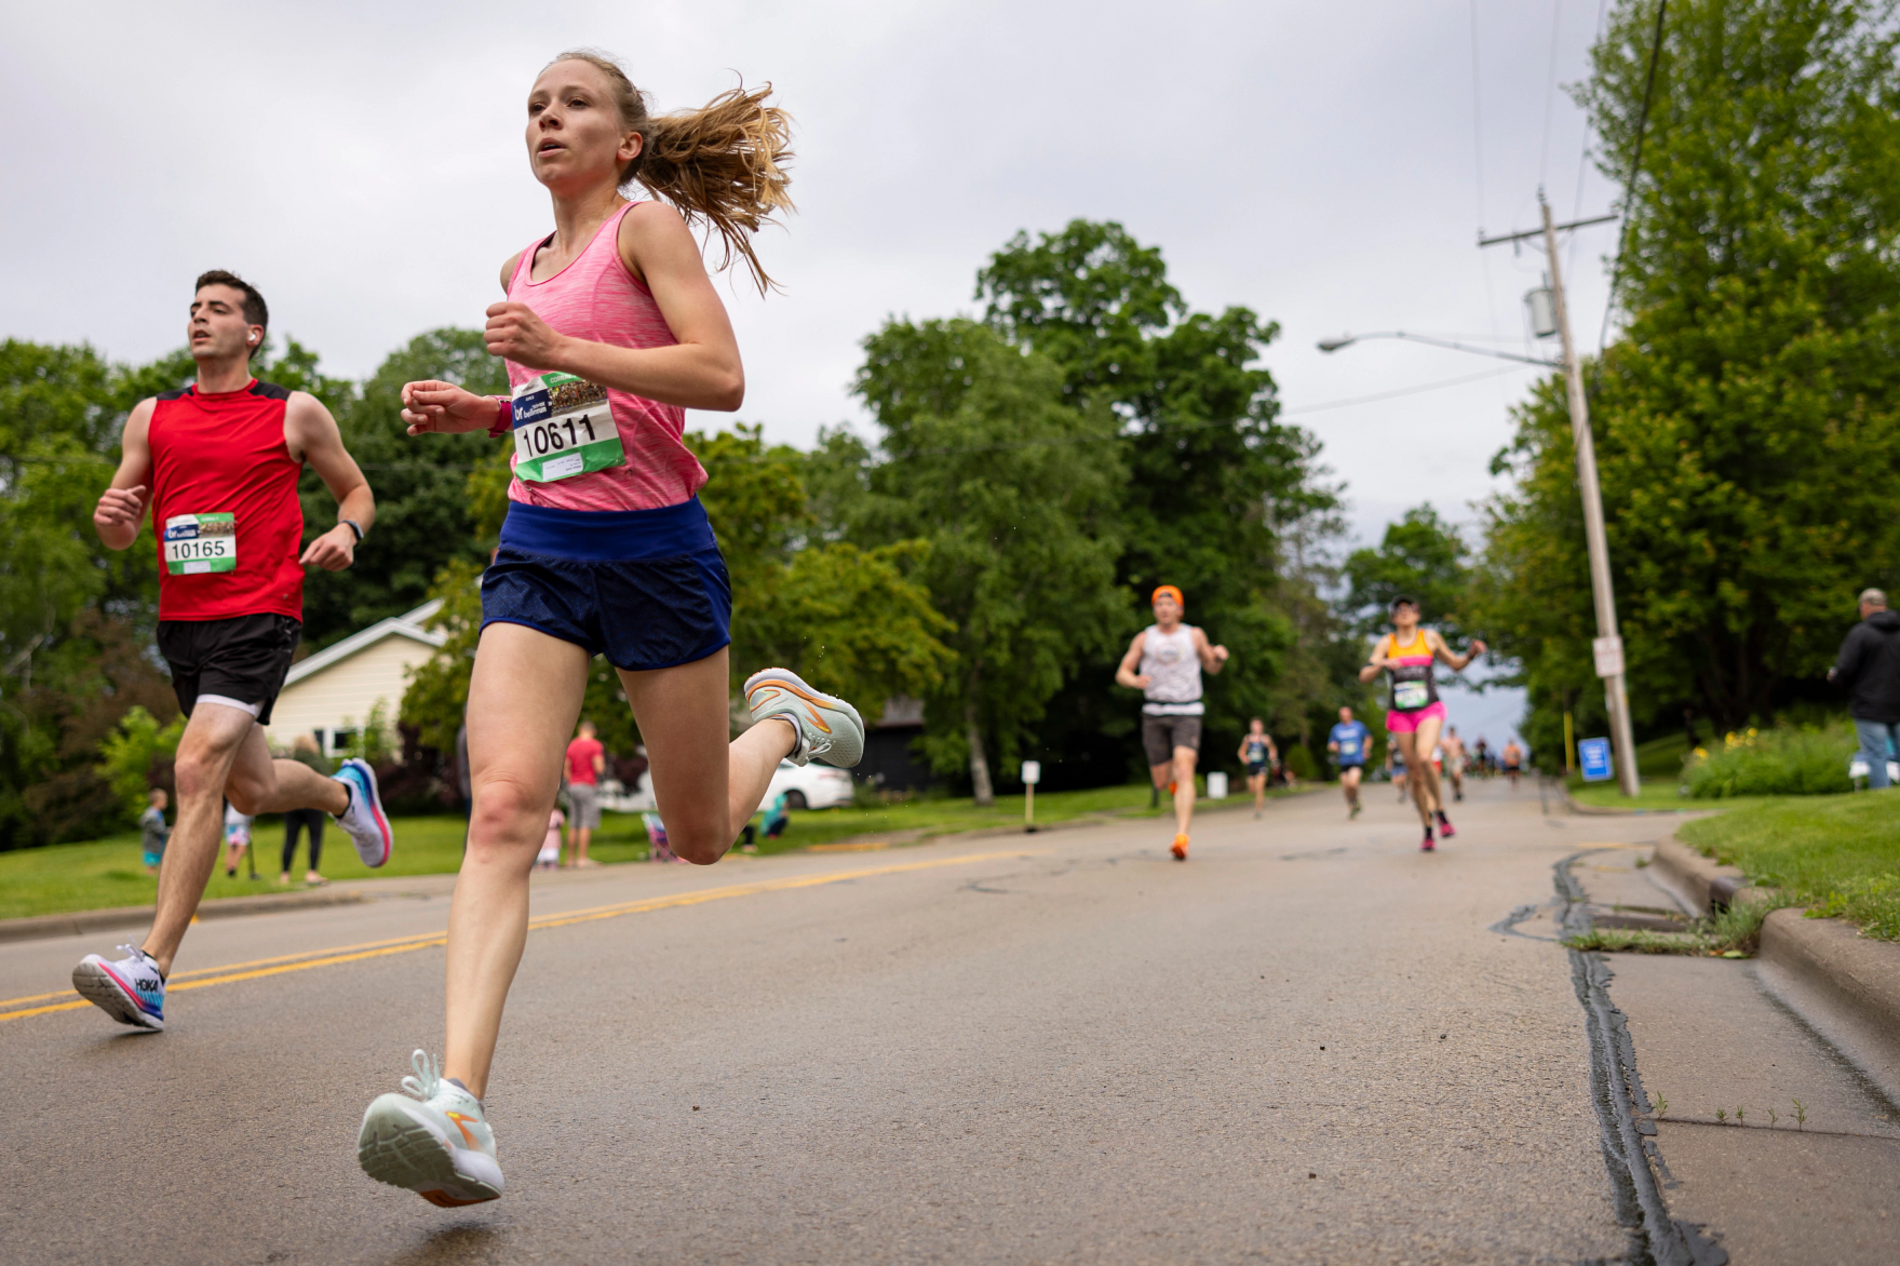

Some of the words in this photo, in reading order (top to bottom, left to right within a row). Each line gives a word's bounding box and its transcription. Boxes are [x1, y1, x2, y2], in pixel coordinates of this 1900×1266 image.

[523, 414, 596, 457] 10611
[172, 540, 225, 559] 10165
[134, 978, 158, 992] HOKA
